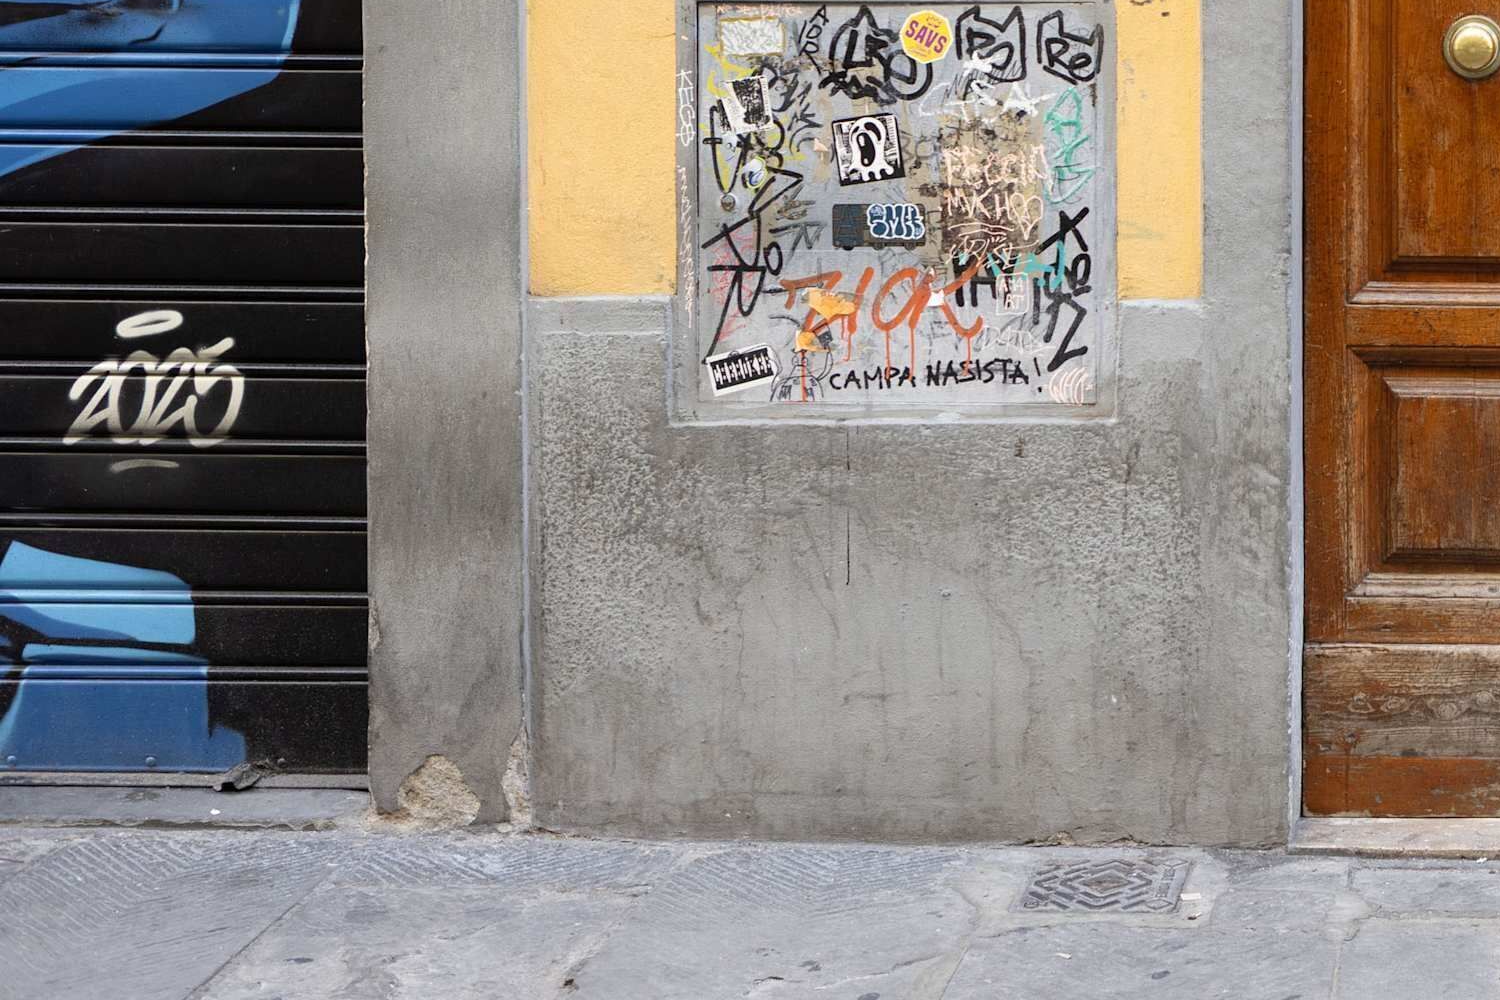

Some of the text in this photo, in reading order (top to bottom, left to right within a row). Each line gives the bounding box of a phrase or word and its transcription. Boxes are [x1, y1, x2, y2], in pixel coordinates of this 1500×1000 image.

[905, 19, 948, 54] SAVS
[829, 366, 917, 391] CAMPA
[926, 356, 1043, 394] NASISTA!
